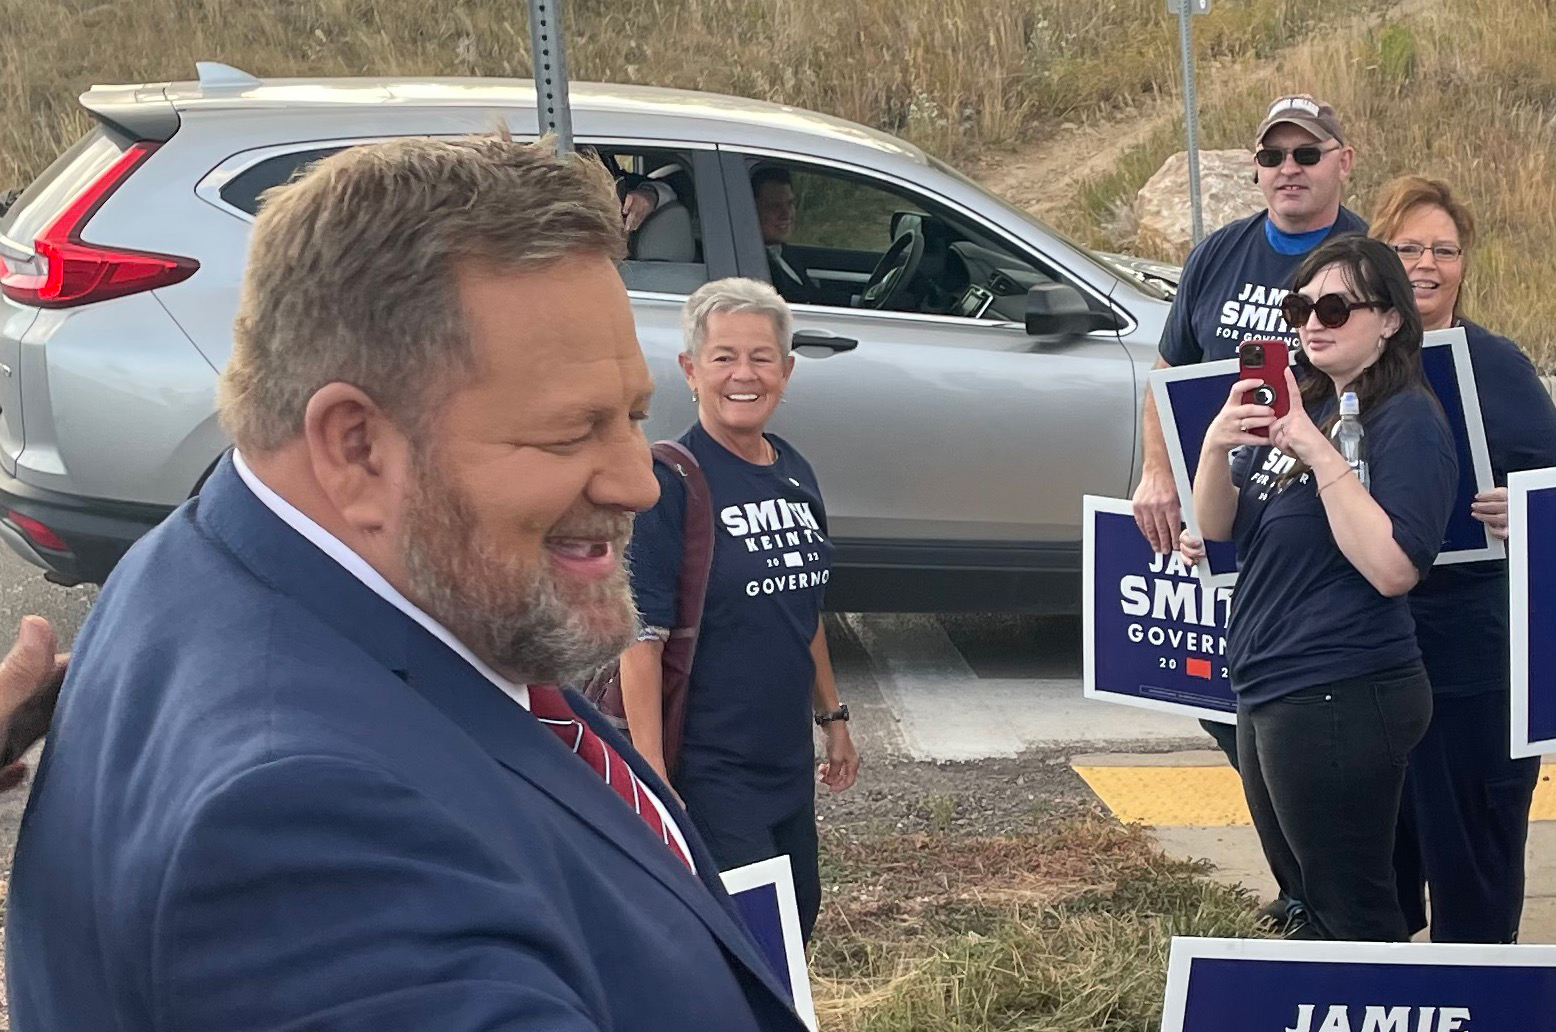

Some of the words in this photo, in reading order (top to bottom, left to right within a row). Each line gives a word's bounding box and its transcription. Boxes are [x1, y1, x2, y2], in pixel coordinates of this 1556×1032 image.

[1216, 326, 1239, 340] FOR
[767, 557, 780, 568] 20
[807, 552, 820, 562] 22
[1159, 657, 1177, 670] 20
